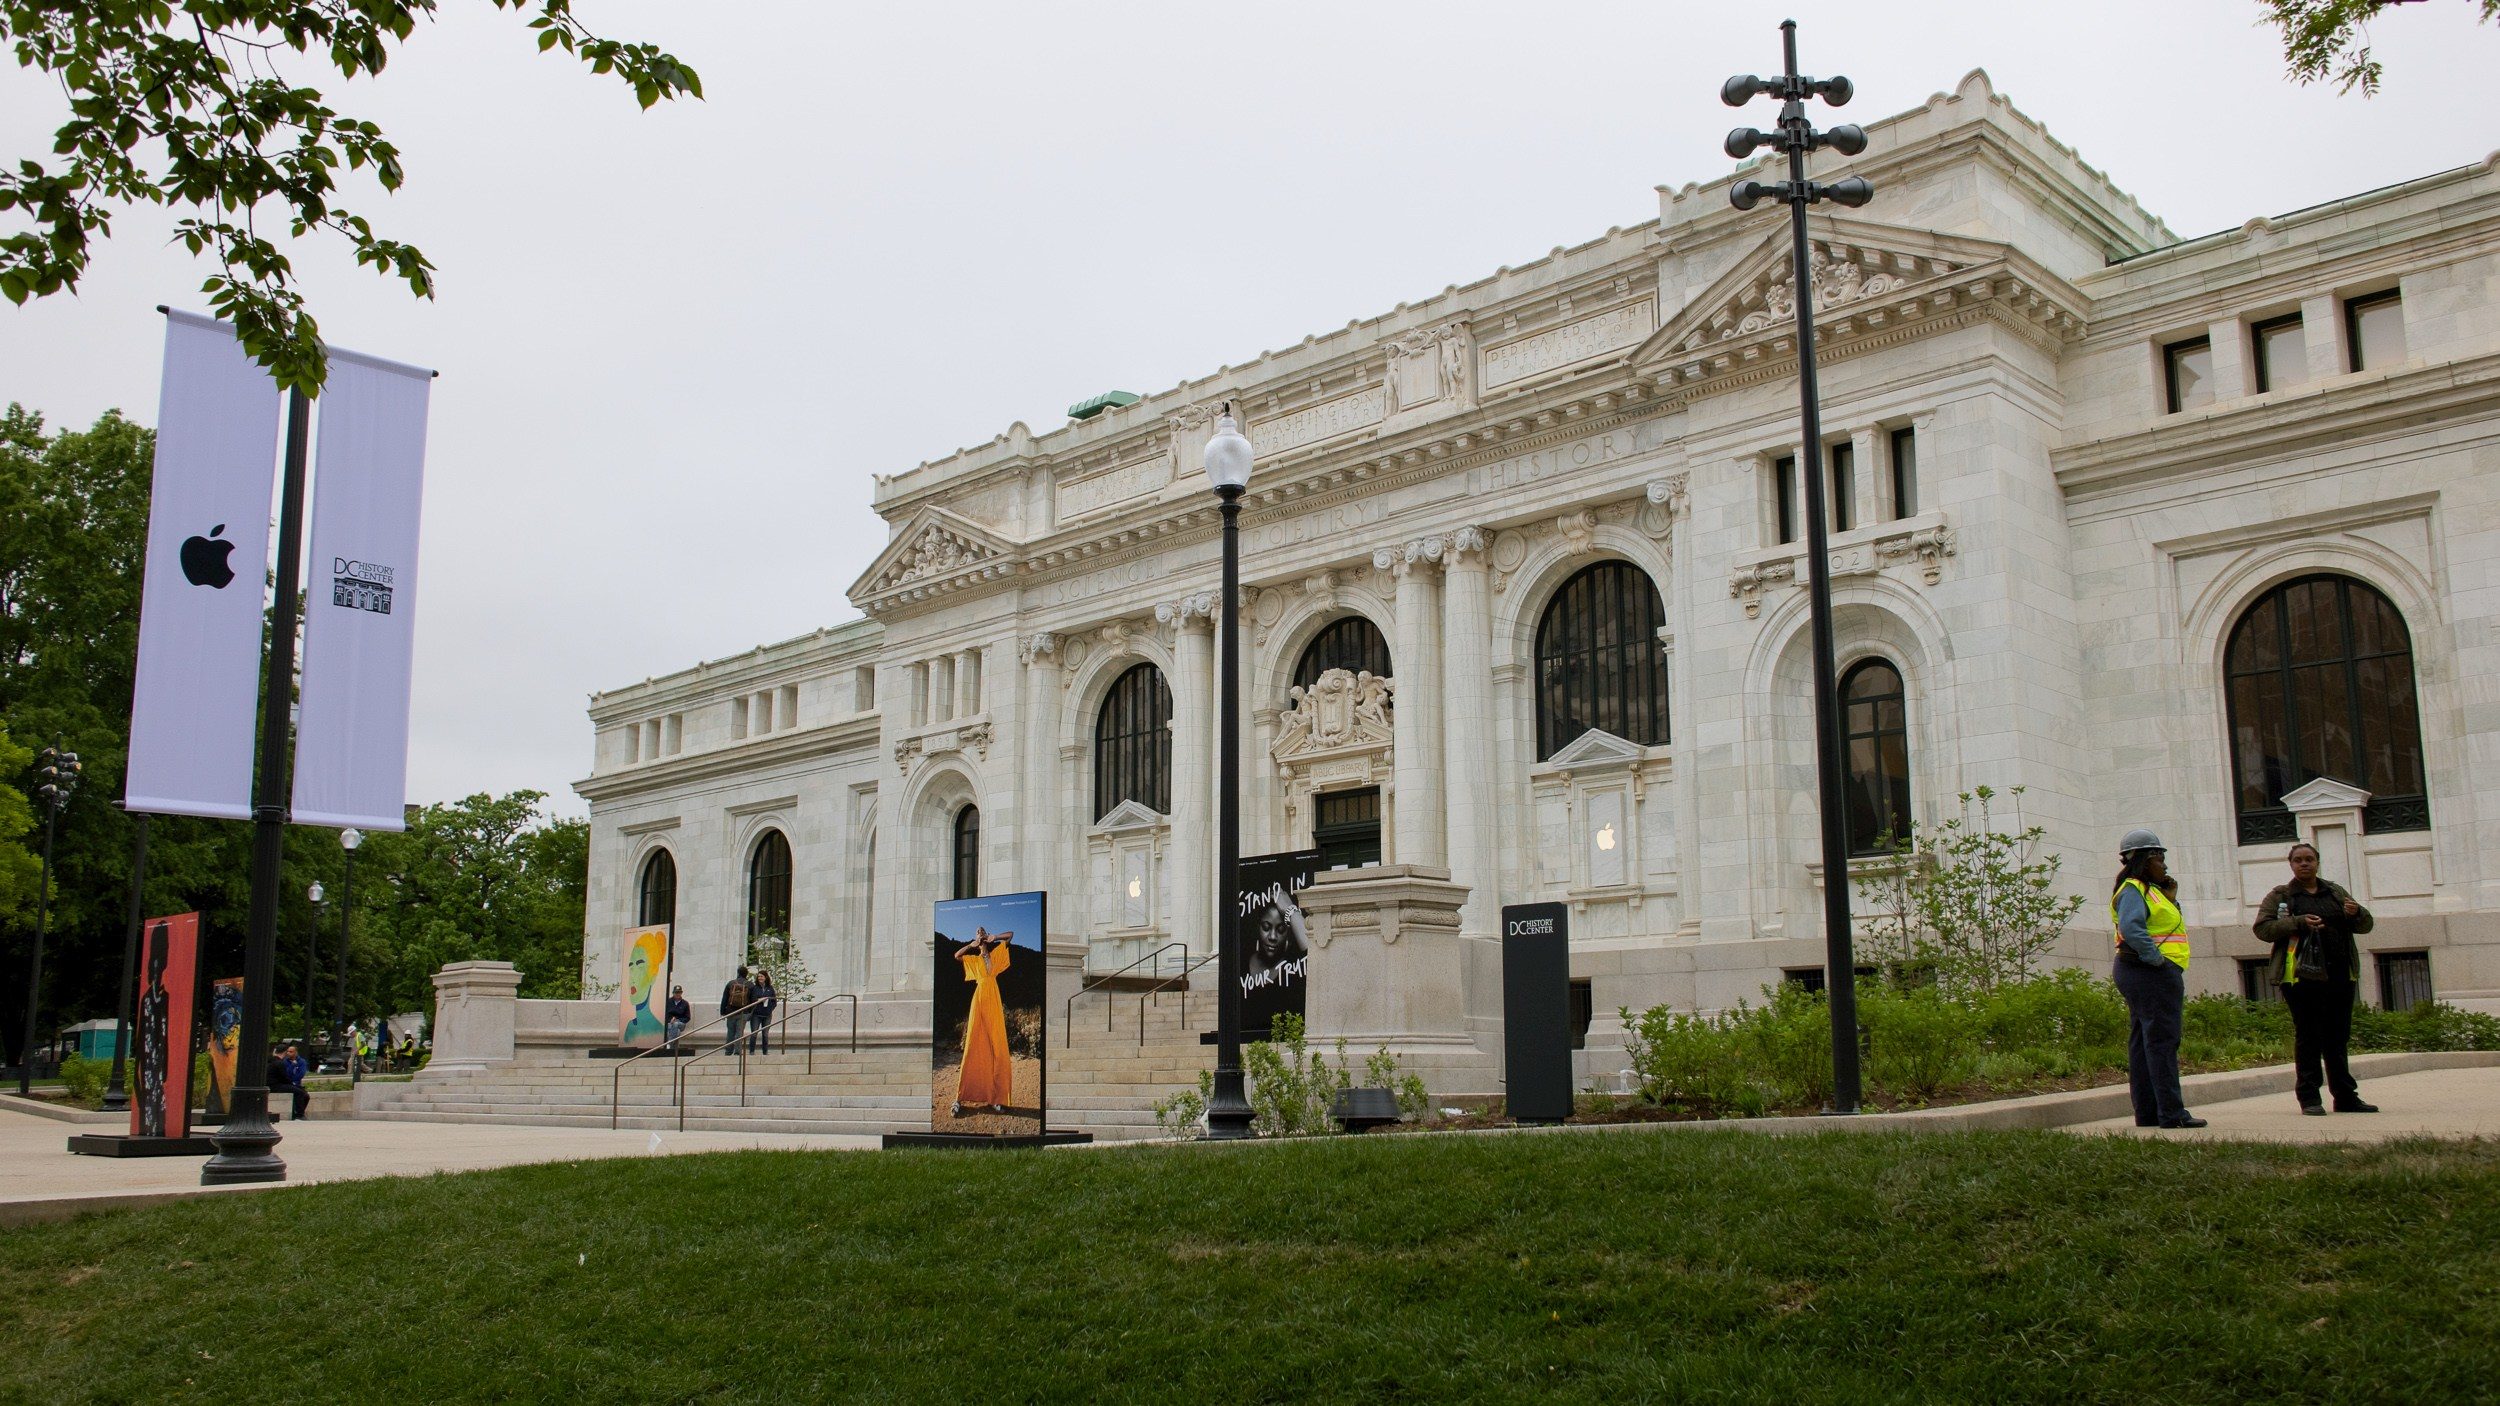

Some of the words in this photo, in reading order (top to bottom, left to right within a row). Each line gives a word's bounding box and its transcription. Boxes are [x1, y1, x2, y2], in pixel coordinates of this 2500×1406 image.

[1491, 325, 1580, 362] DEDICATED
[1590, 317, 1607, 331] TO
[1618, 303, 1649, 322] THE
[1502, 330, 1601, 370] DIFFVSION
[1613, 321, 1633, 335] OF
[1519, 337, 1617, 376] KNOWLEDGE
[1261, 393, 1375, 438] WASHINGTON
[1314, 404, 1382, 438] LIBRARY
[1489, 428, 1644, 489] HISTORY
[1251, 501, 1370, 552] POETRY
[334, 557, 358, 577] DC
[358, 562, 394, 576] HISTORY
[357, 571, 394, 584] CENTER
[1057, 559, 1155, 602] SCIENCE
[1290, 872, 1305, 895] IN
[1510, 920, 1527, 936] DC
[1526, 918, 1553, 927] HISTORY
[1526, 926, 1554, 935] CENTER
[1240, 967, 1274, 999] YOUR
[1274, 956, 1307, 987] TRUT
